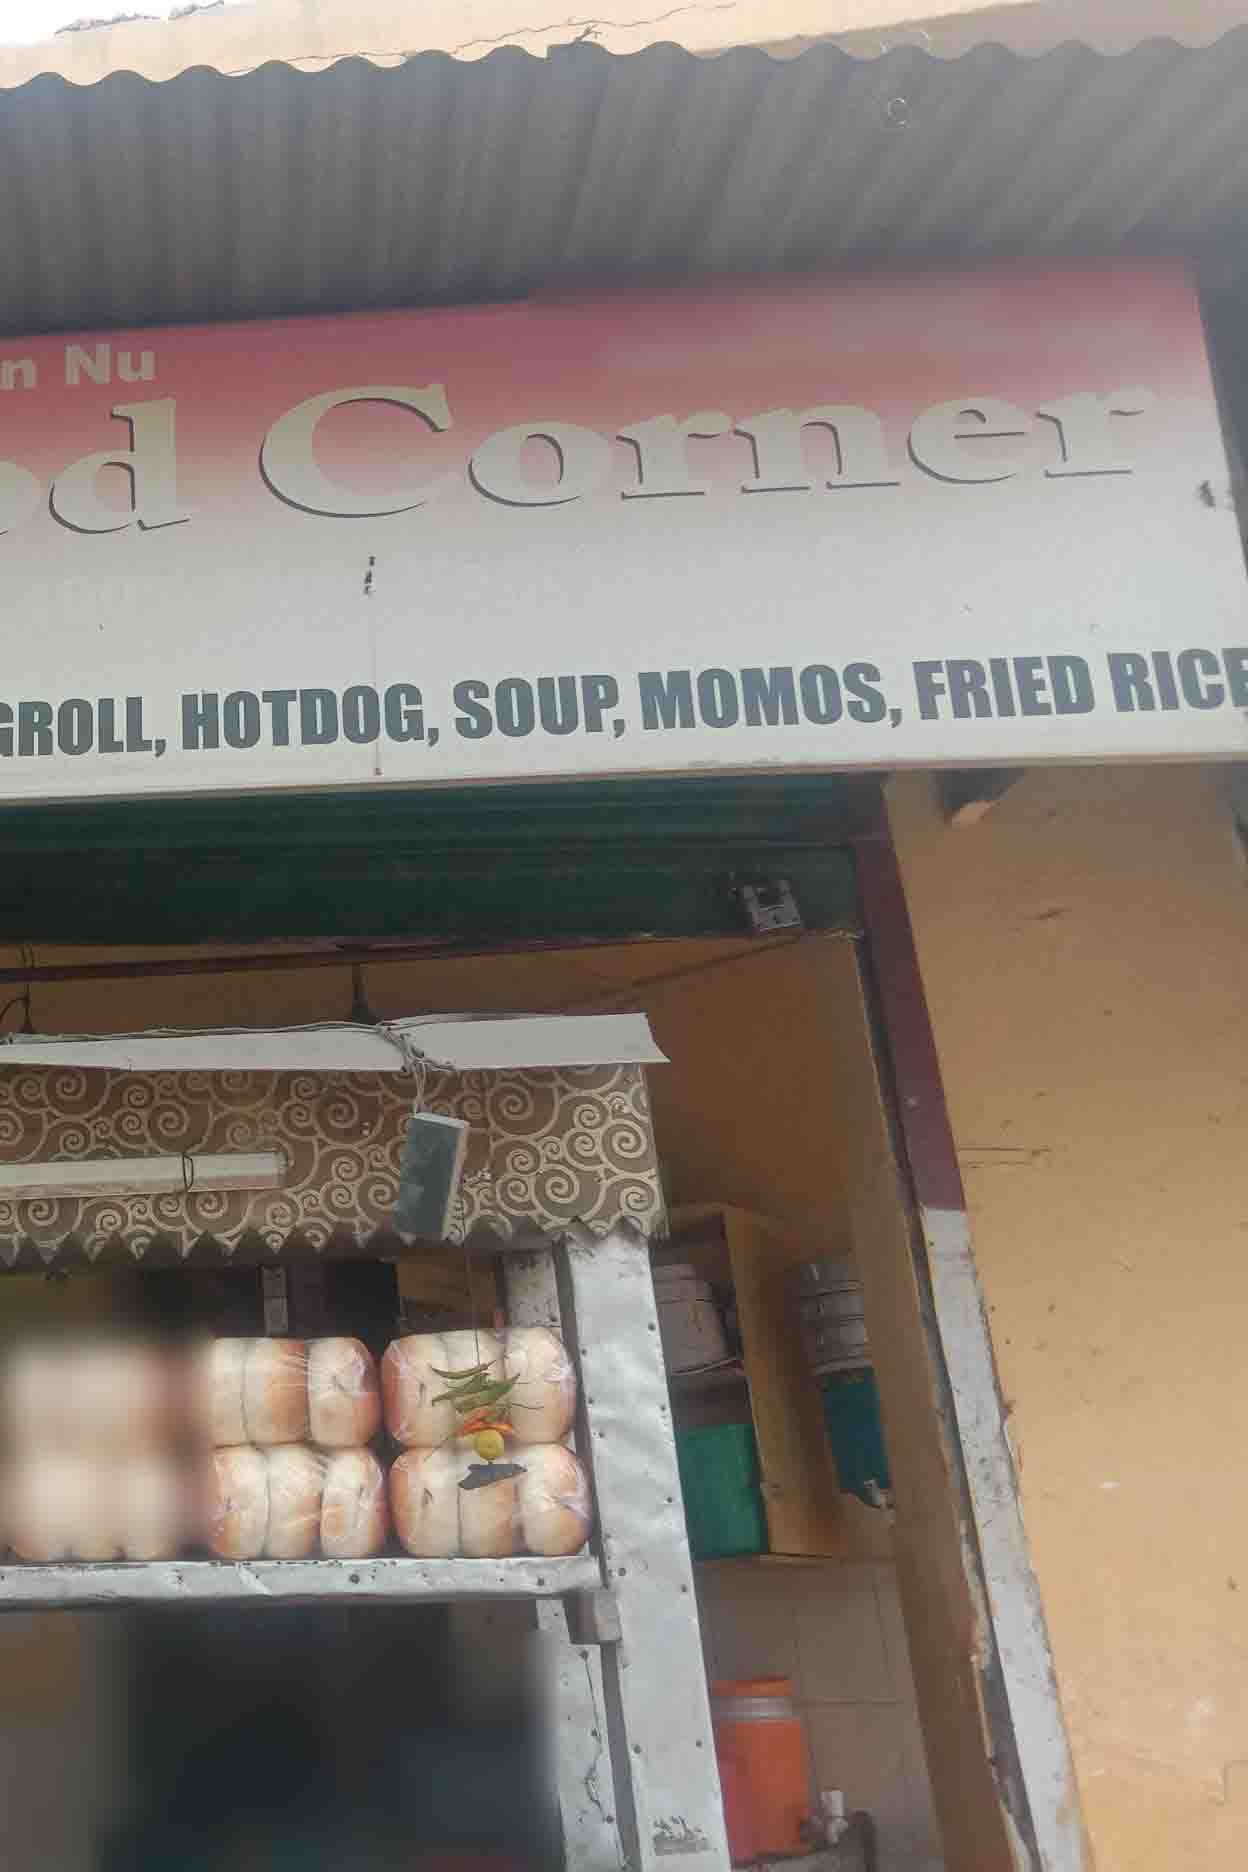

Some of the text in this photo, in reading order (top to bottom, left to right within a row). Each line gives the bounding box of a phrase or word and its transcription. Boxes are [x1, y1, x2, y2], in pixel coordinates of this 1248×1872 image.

[65, 344, 158, 384] Nu
[259, 382, 1152, 517] Corner
[182, 682, 440, 749] HOTDOG,
[454, 674, 626, 739] SOUP,
[639, 662, 902, 730] MOMOS,
[912, 655, 1096, 720] FRIED
[1107, 647, 1248, 712] RICE
